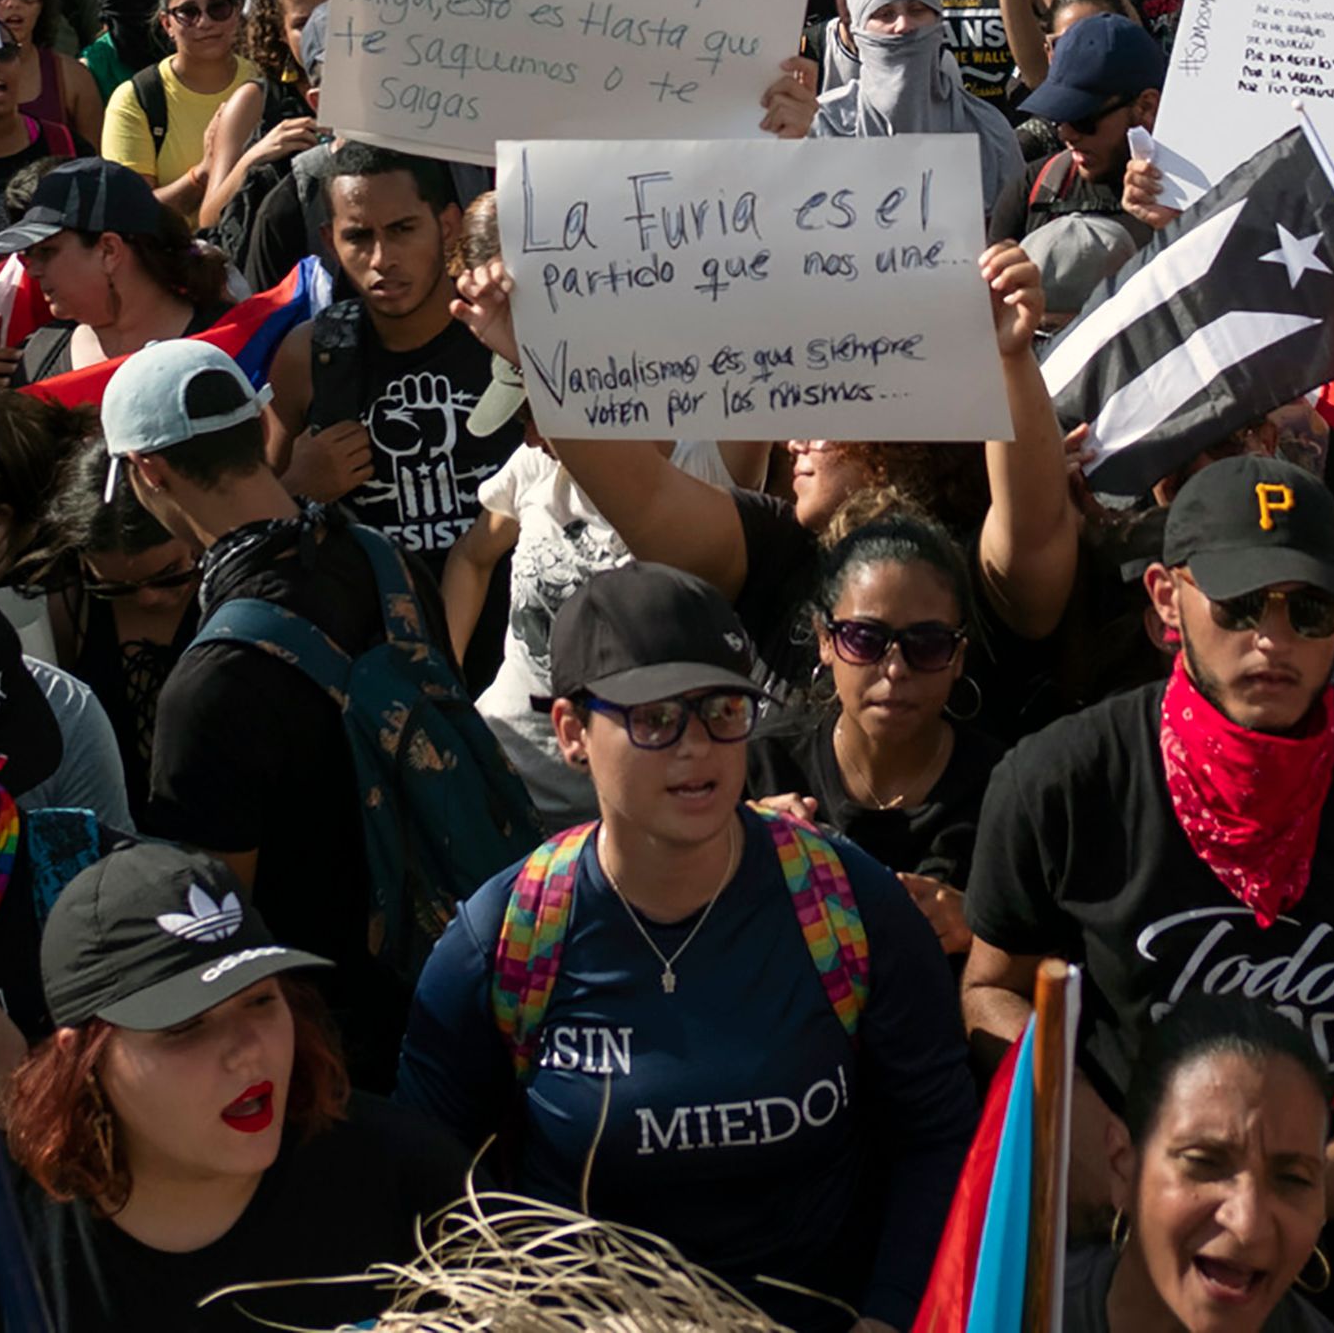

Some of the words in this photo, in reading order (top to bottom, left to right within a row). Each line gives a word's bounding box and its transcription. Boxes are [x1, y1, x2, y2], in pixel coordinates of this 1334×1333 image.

[333, 16, 387, 57] te
[604, 70, 623, 92] o
[650, 72, 699, 105] te
[530, 0, 564, 28] es
[579, 1, 684, 51] Hasta
[696, 29, 761, 75] que
[941, 18, 1007, 47] ANS
[522, 146, 597, 254] La
[624, 170, 762, 253] Furia
[794, 188, 857, 232] es
[875, 168, 935, 232] el
[542, 252, 674, 313] partido
[694, 249, 772, 302] que
[804, 249, 858, 283] nos
[522, 339, 699, 408] Vandalismo
[752, 346, 794, 384] que
[667, 390, 707, 427] por
[723, 379, 755, 419] los
[383, 517, 475, 551] ESIST
[1254, 482, 1295, 530] P
[635, 1065, 848, 1155] MIEDO!
